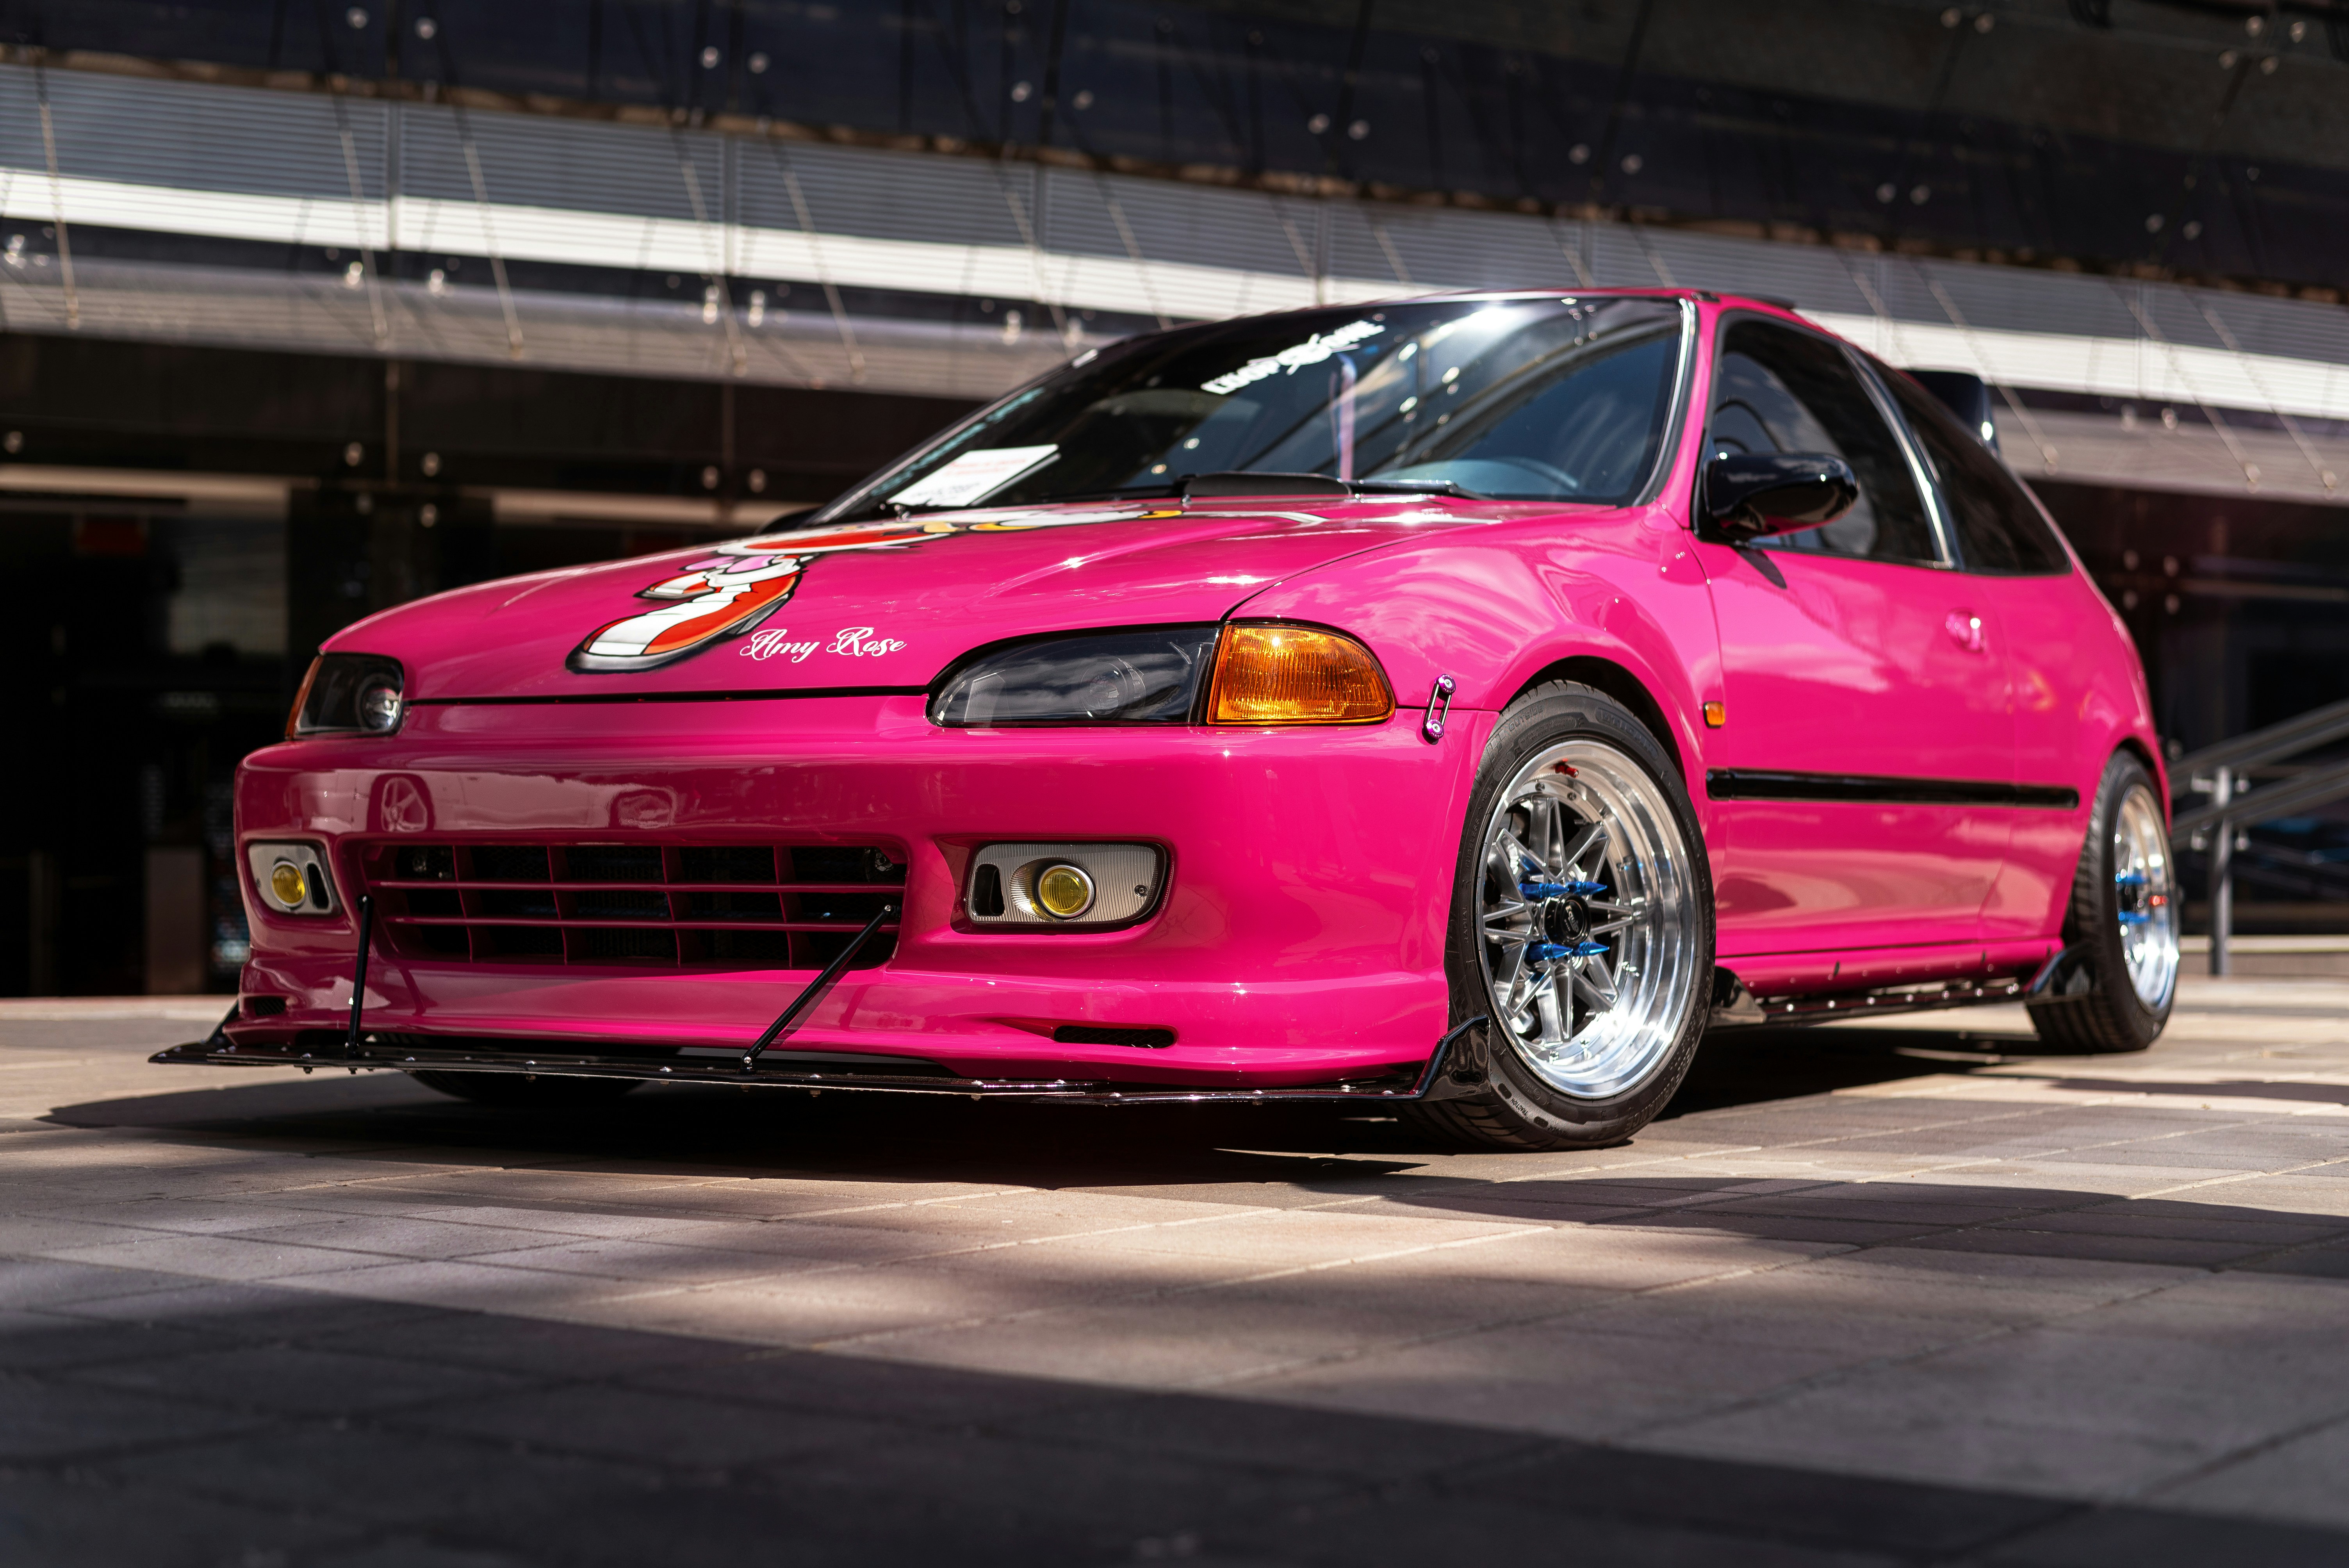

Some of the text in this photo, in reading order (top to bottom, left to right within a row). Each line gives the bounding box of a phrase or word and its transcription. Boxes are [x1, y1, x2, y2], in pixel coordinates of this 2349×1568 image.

[739, 627, 907, 663] Amy Rose
[1508, 704, 1544, 732] OUTSIDE
[1482, 786, 1491, 804] MADE
[1465, 818, 1480, 870] TUBELESS
[1510, 1098, 1529, 1115] TRACTION
